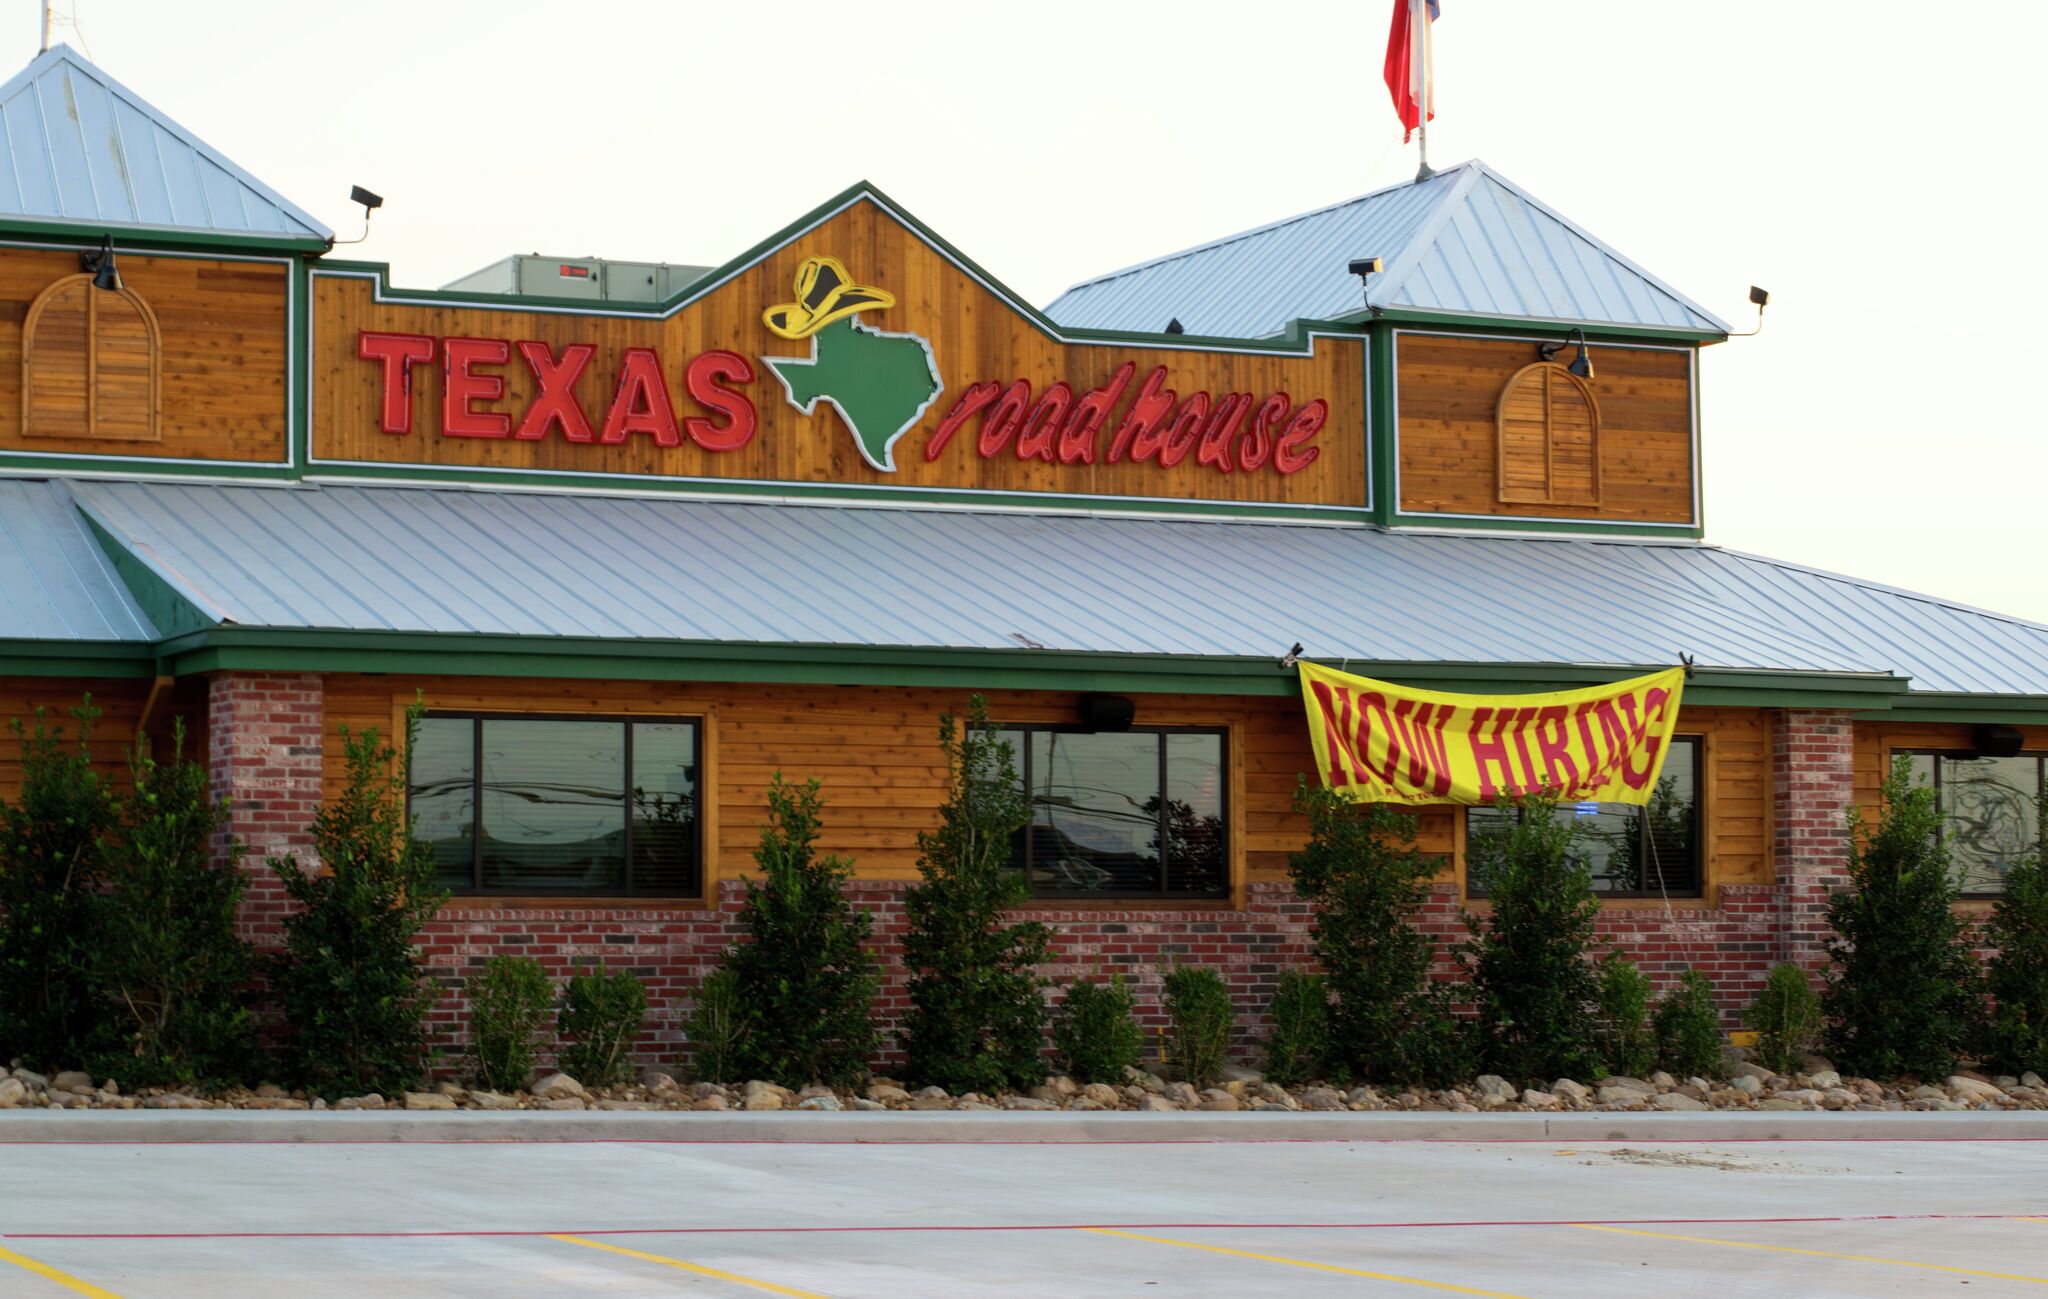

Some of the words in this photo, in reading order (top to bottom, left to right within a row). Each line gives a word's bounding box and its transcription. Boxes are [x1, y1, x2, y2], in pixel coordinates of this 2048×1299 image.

[359, 331, 757, 452] TEXAS
[924, 360, 1328, 475] roadhouse
[1311, 680, 1455, 796] NOW
[1468, 687, 1671, 800] HIRING
